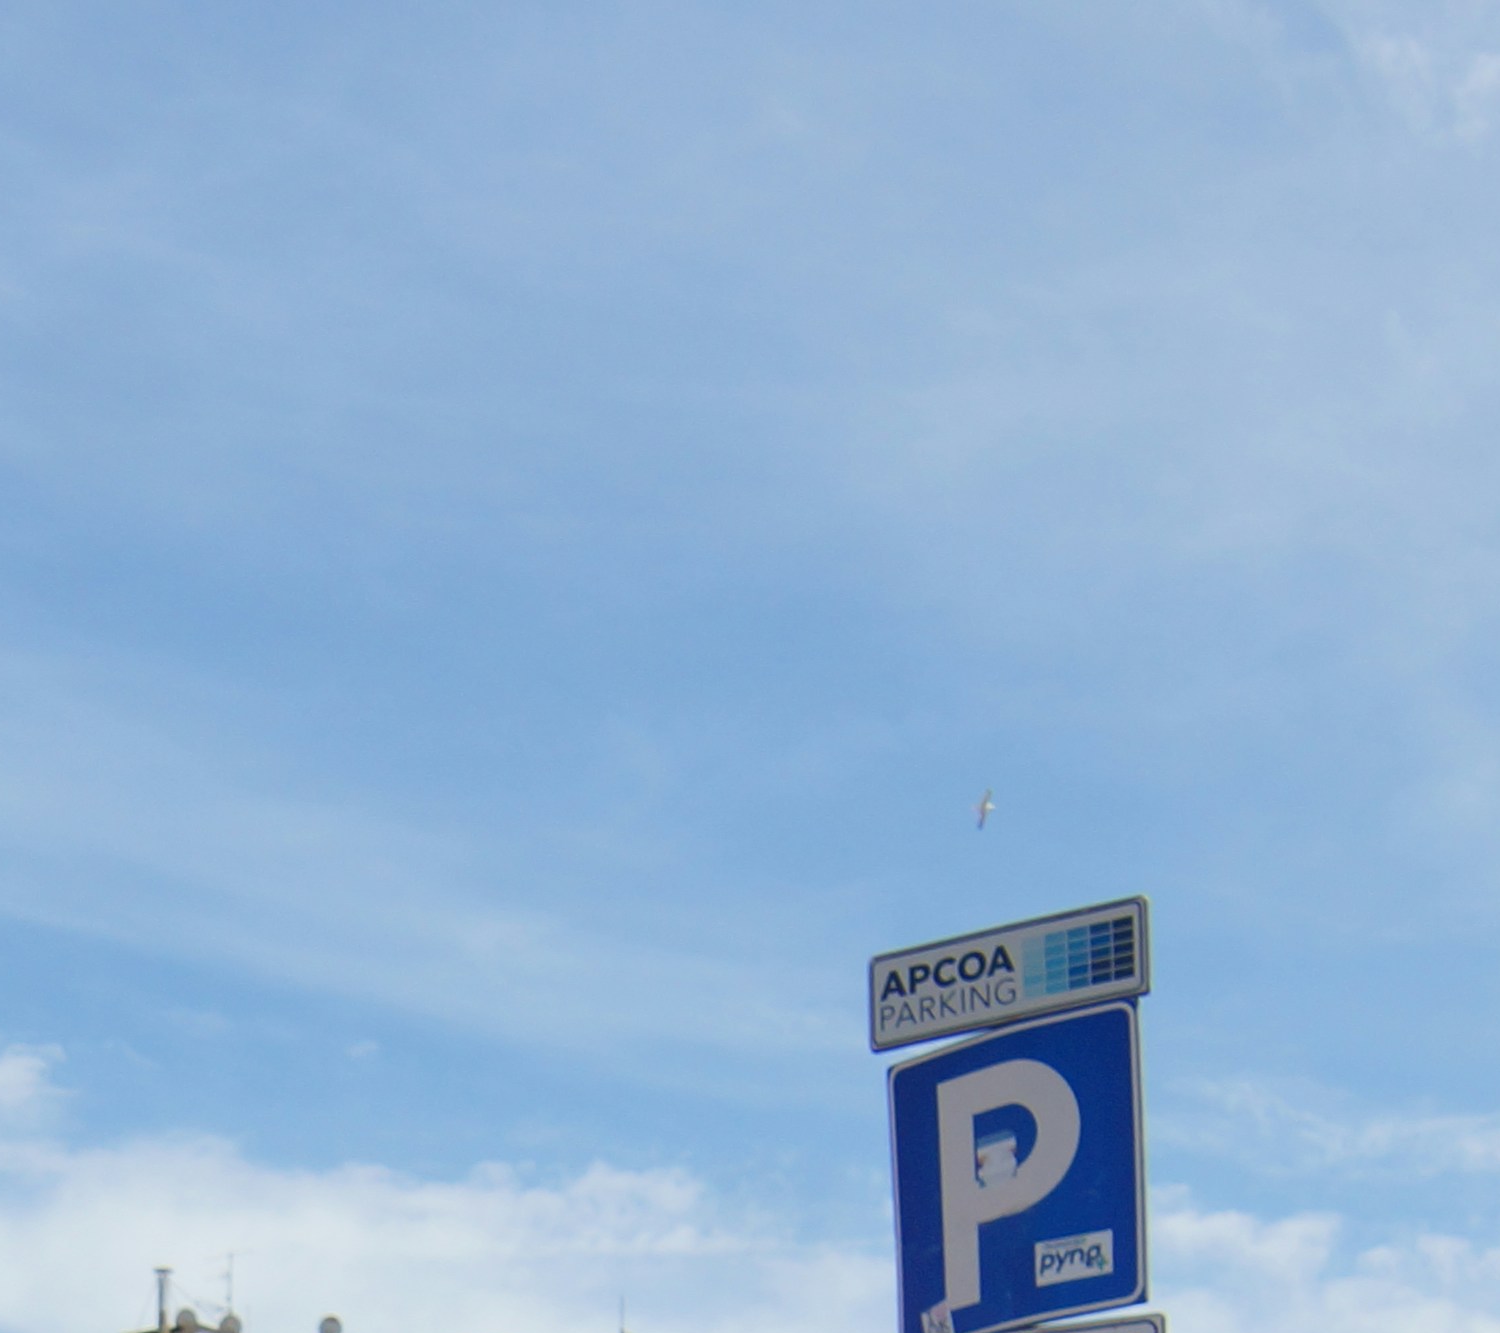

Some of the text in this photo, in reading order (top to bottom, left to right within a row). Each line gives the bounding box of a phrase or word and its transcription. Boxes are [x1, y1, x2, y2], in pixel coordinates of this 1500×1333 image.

[880, 945, 1015, 1000] APCOA
[879, 977, 1017, 1032] PARKING
[937, 1058, 1081, 1311] P
